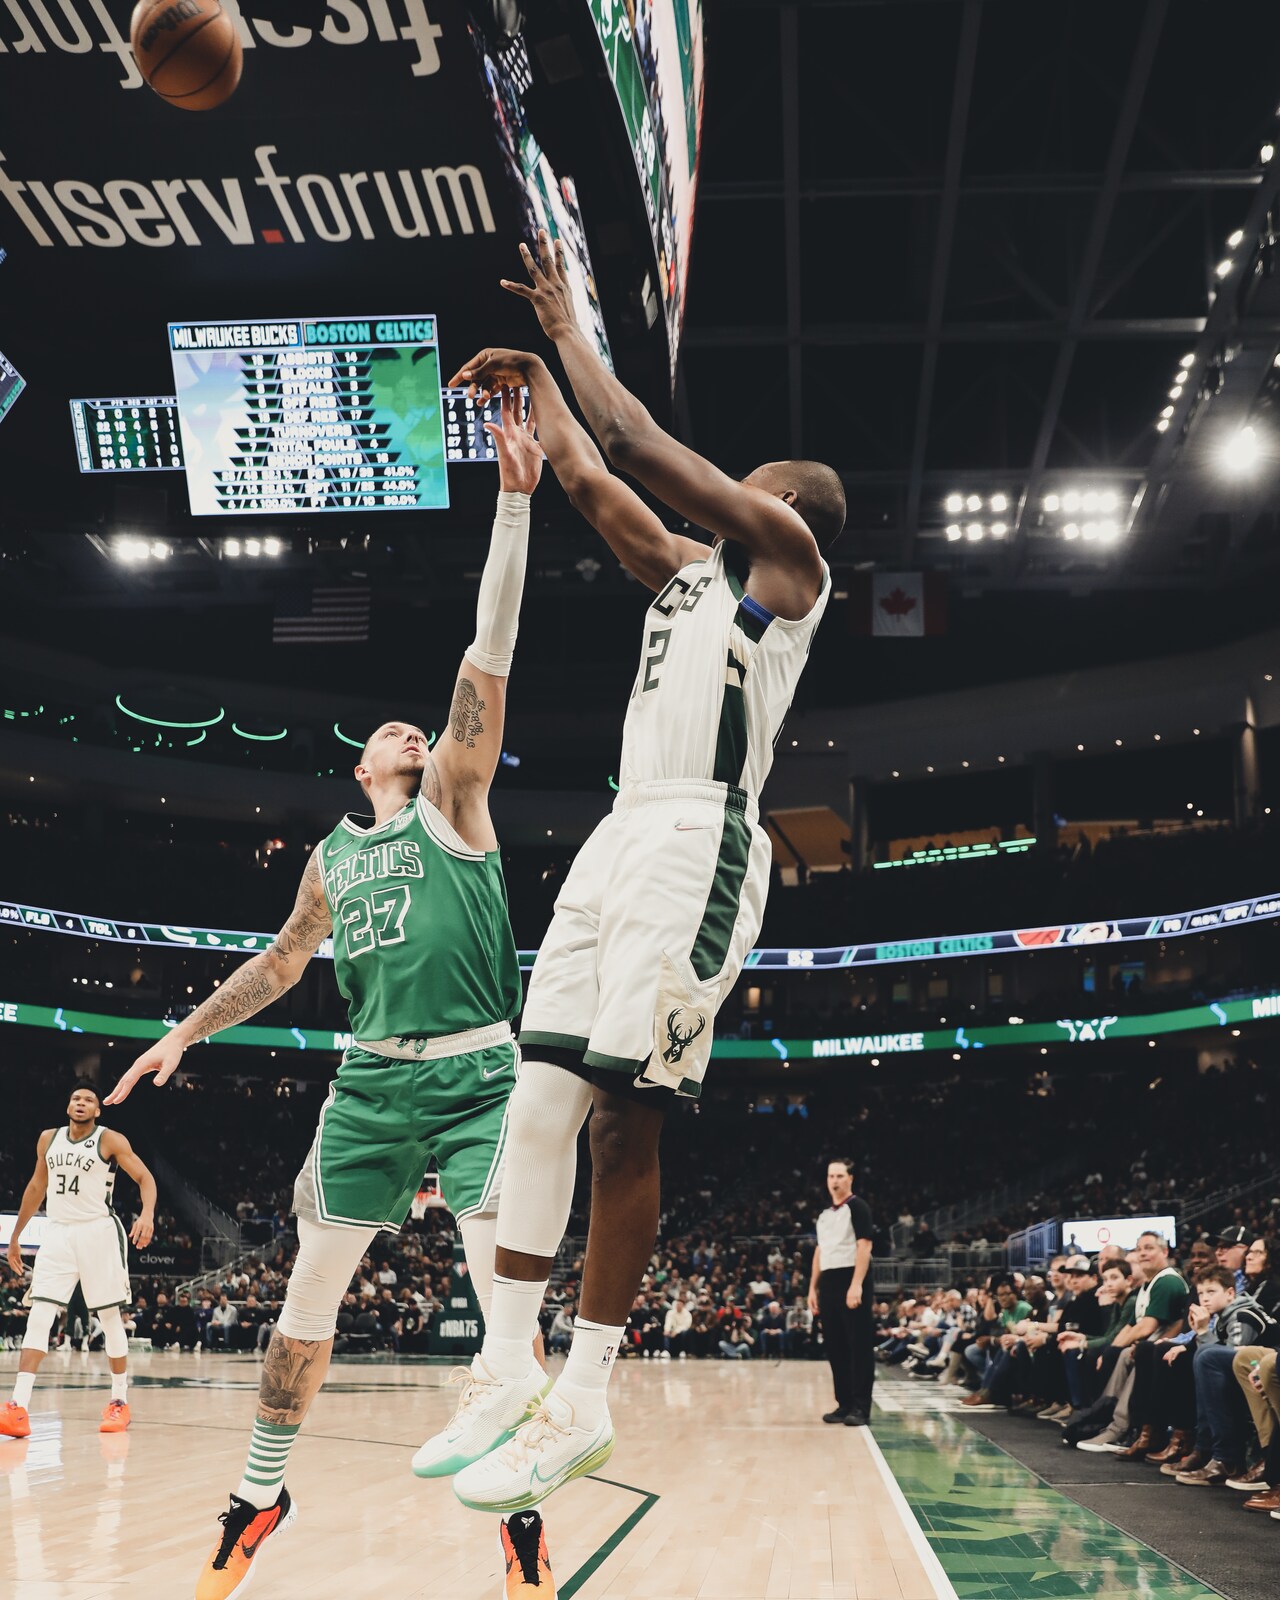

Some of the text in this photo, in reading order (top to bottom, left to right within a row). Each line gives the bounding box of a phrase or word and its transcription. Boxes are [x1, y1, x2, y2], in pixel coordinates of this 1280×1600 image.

[172, 324, 298, 348] MILWAUKEE BUCKS
[305, 320, 433, 343] BOSTON CELTICS
[344, 351, 358, 363] 14
[280, 366, 333, 381] BLOCKS
[282, 381, 334, 395] STEALS
[282, 396, 307, 410] OFF
[309, 395, 337, 409] REB
[447, 398, 455, 410] 7
[114, 408, 123, 419] 0
[131, 407, 140, 419] 0
[166, 406, 173, 418] 1
[283, 411, 309, 424] DEF
[311, 410, 338, 423] REB
[350, 409, 362, 421] 17
[465, 410, 475, 422] 11
[133, 420, 141, 432] 4
[168, 419, 174, 430] 1
[271, 423, 353, 438] TURNOVERS
[368, 423, 376, 434] 7
[118, 433, 126, 444] 4
[136, 432, 142, 444] 1
[153, 432, 159, 443] 1
[170, 431, 176, 443] 1
[467, 435, 475, 447] 7
[486, 434, 492, 446] 1
[119, 445, 128, 457] 0
[154, 444, 160, 456] 1
[170, 444, 179, 455] 0
[270, 439, 312, 453] TOTAL
[313, 438, 357, 452] FOULS
[370, 438, 379, 450] 4
[486, 447, 495, 459] 0
[119, 457, 132, 469] 10
[138, 457, 146, 469] 4
[156, 456, 162, 468] 1
[172, 456, 180, 468] 0
[314, 452, 363, 466] POINTS
[382, 479, 416, 492] 44.0%
[310, 495, 327, 509] FT
[324, 841, 424, 912] CELTICS
[65, 919, 73, 930] 4
[88, 921, 112, 936] TOL
[340, 885, 411, 959] 27
[876, 936, 993, 960] BOSTON CELTICS
[787, 950, 814, 967] 52
[812, 1032, 924, 1058] MILWAUKEE
[48, 1153, 95, 1172] BUCKS
[56, 1174, 80, 1196] 34
[140, 1253, 175, 1264] clover
[439, 1319, 478, 1338] #NBA75
